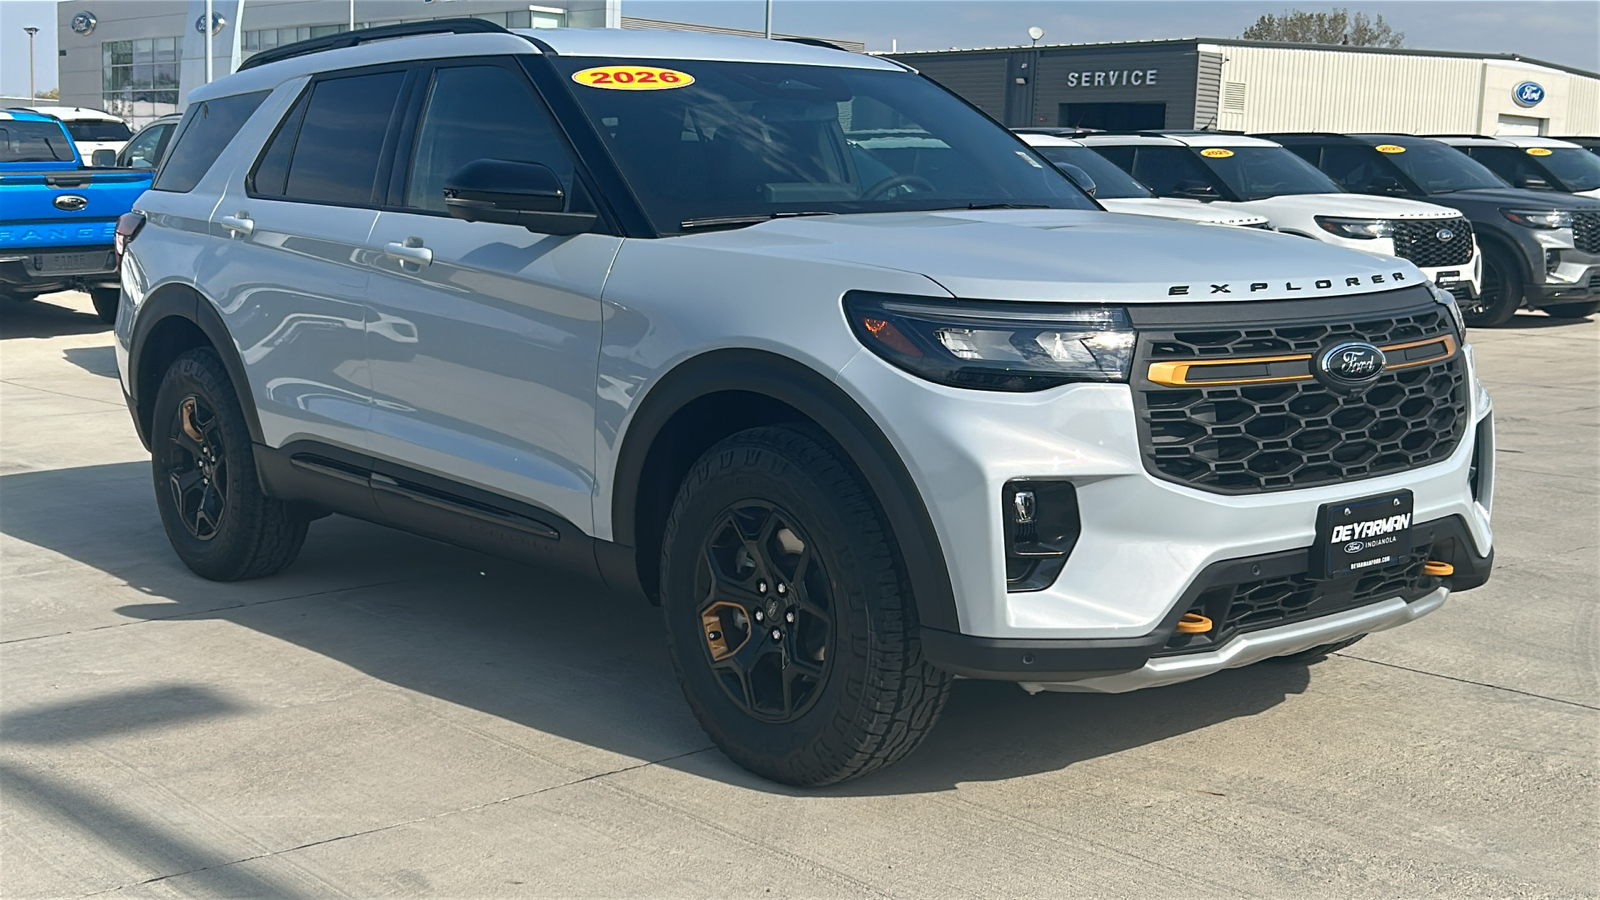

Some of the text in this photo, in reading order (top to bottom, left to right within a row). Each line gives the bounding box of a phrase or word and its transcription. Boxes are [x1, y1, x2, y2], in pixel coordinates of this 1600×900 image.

[590, 71, 681, 84] 2026
[1067, 69, 1158, 88] SERVICE
[1522, 85, 1541, 101] Ford
[1168, 271, 1406, 296] EXPLORER
[1341, 351, 1375, 374] Ford
[1330, 512, 1411, 544] DEYARMAN
[1365, 535, 1397, 549] INDIANOLA
